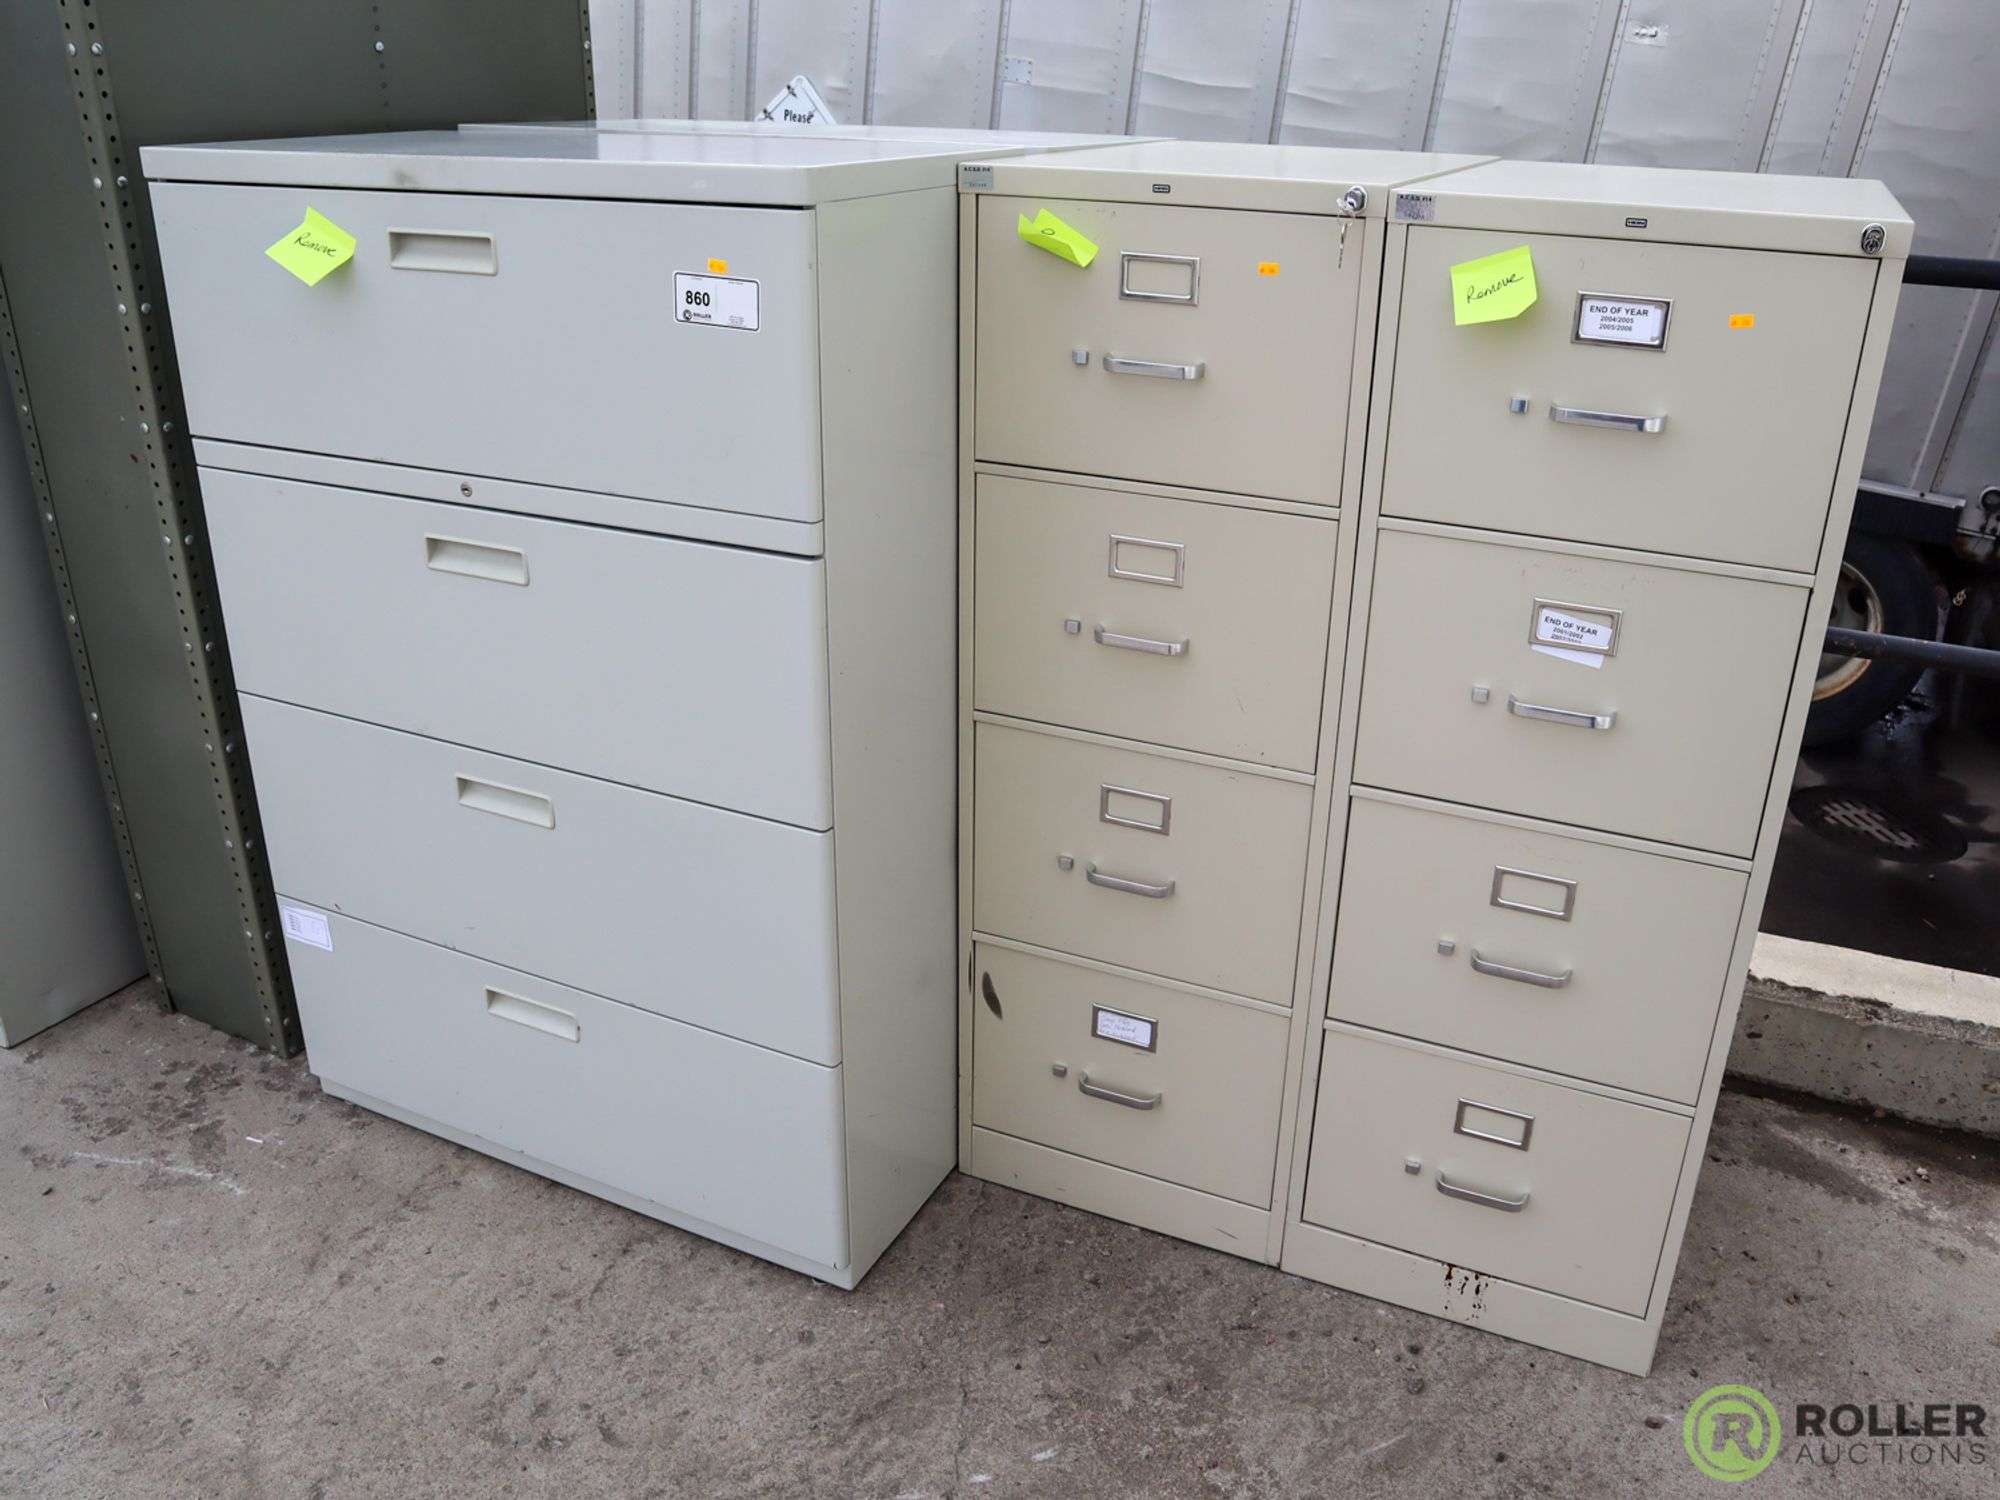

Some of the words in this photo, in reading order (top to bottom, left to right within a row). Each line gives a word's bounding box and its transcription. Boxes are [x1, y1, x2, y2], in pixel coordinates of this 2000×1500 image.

[783, 109, 815, 124] Please
[294, 232, 337, 257] Remove
[1466, 273, 1524, 304] Remove
[685, 290, 711, 307] 860
[1589, 305, 1608, 314] END
[1610, 306, 1622, 315] OF
[1625, 308, 1649, 317] YEAR
[1544, 615, 1561, 626] END
[1576, 625, 1598, 636] YEAR
